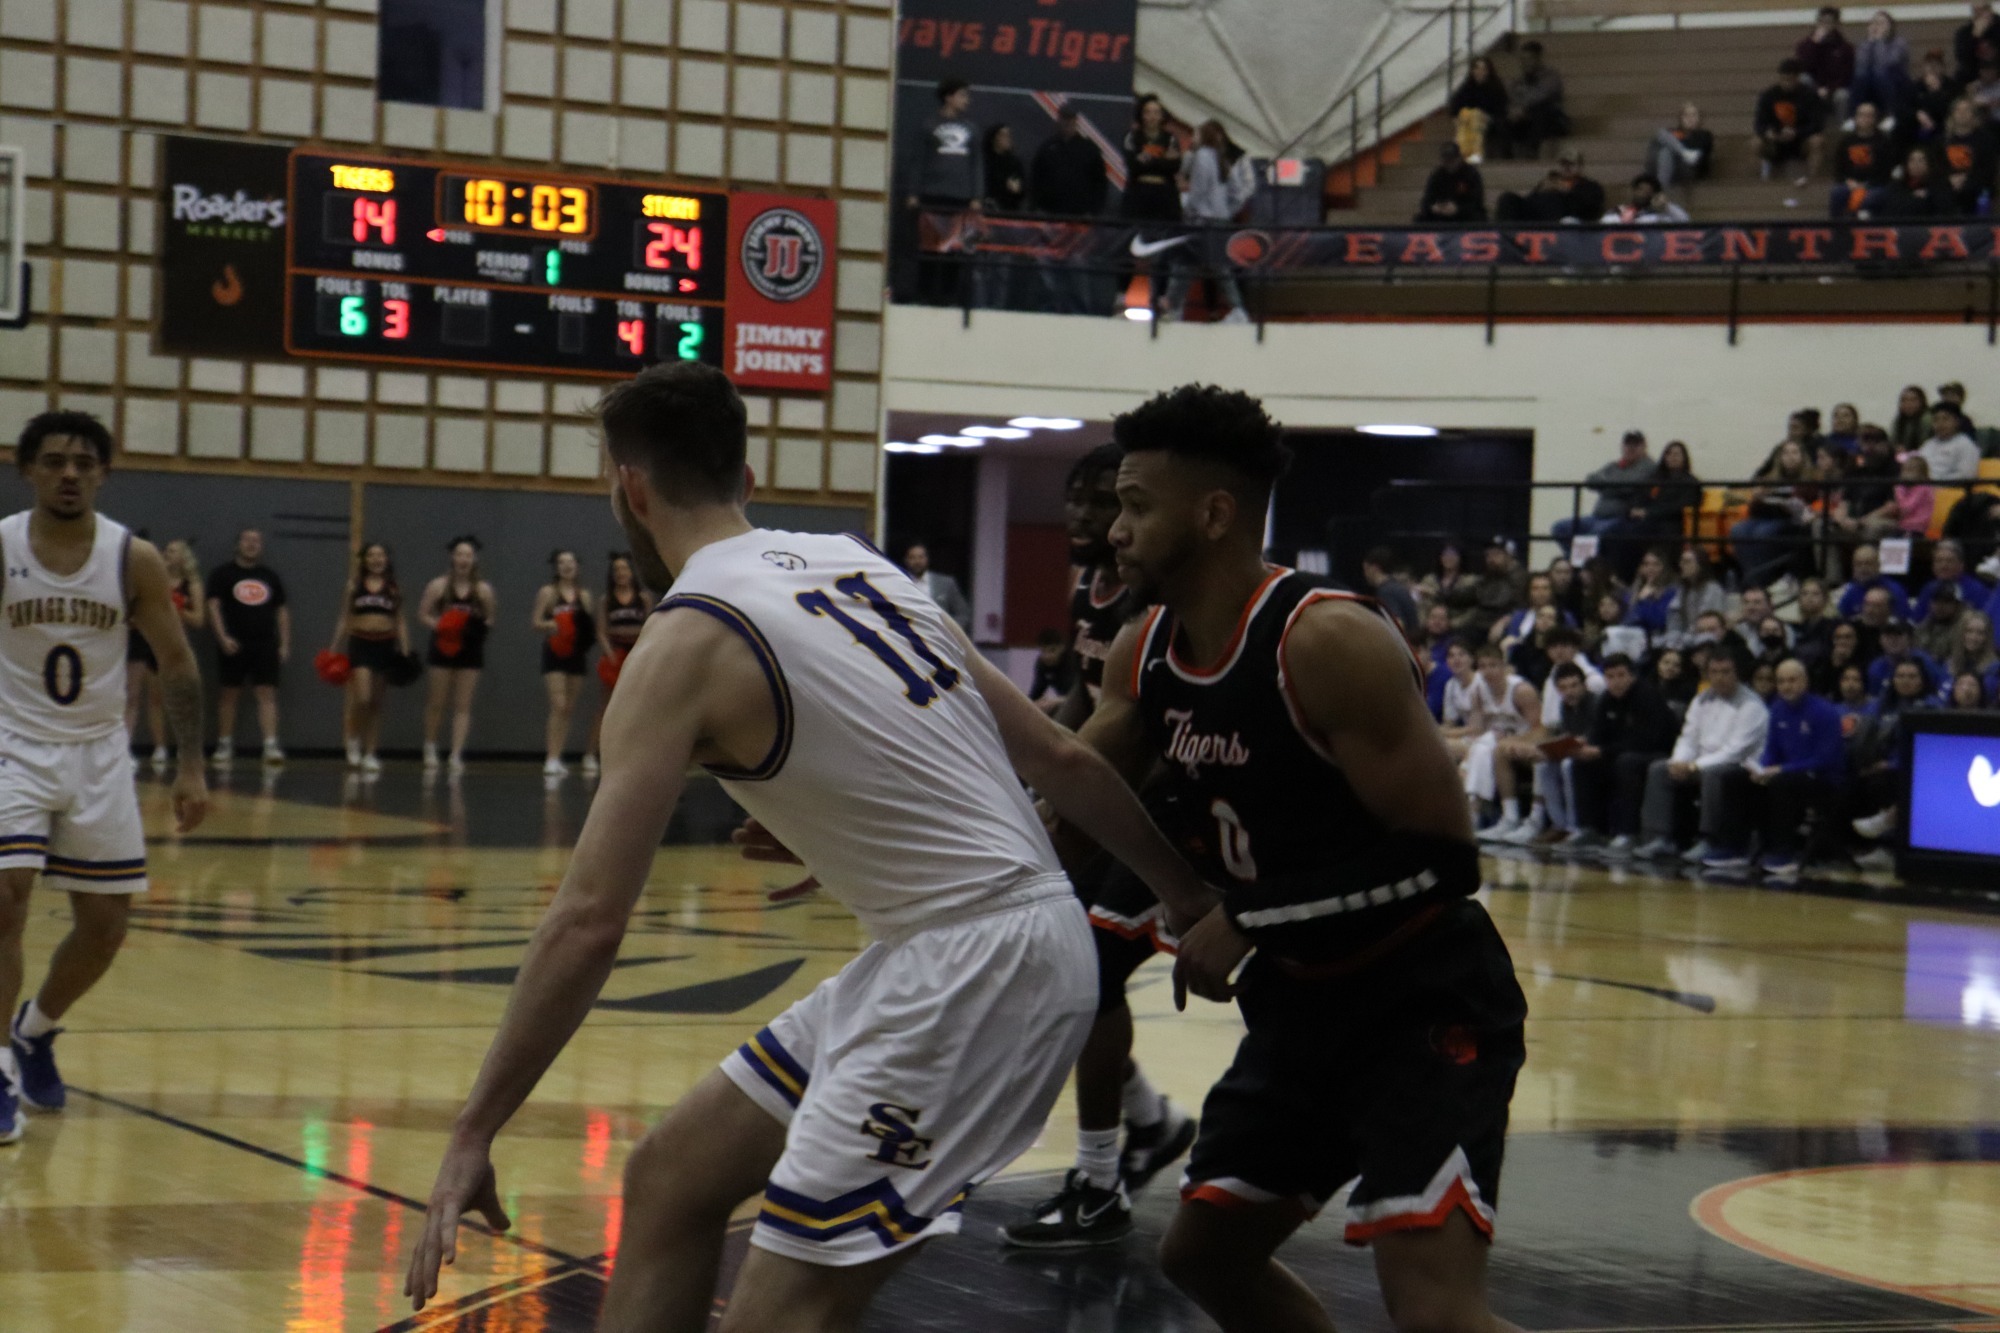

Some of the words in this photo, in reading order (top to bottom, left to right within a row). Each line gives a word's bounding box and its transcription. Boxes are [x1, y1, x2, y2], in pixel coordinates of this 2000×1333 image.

[993, 24, 1017, 54] a
[1028, 18, 1130, 68] Tiger
[353, 197, 396, 245] 14
[464, 179, 587, 233] 10:03
[642, 195, 700, 220] STORM
[646, 222, 702, 271] 24
[1344, 232, 1557, 263] EAST
[546, 249, 561, 285] 1
[340, 296, 368, 336] 6
[383, 300, 410, 339] 3
[735, 322, 825, 349] JIMMY
[618, 319, 645, 356] 4
[678, 322, 704, 360] 2
[733, 348, 824, 375] JOHN'S
[795, 571, 961, 708] 11
[43, 641, 84, 706] 0
[1163, 708, 1251, 779] Tigers
